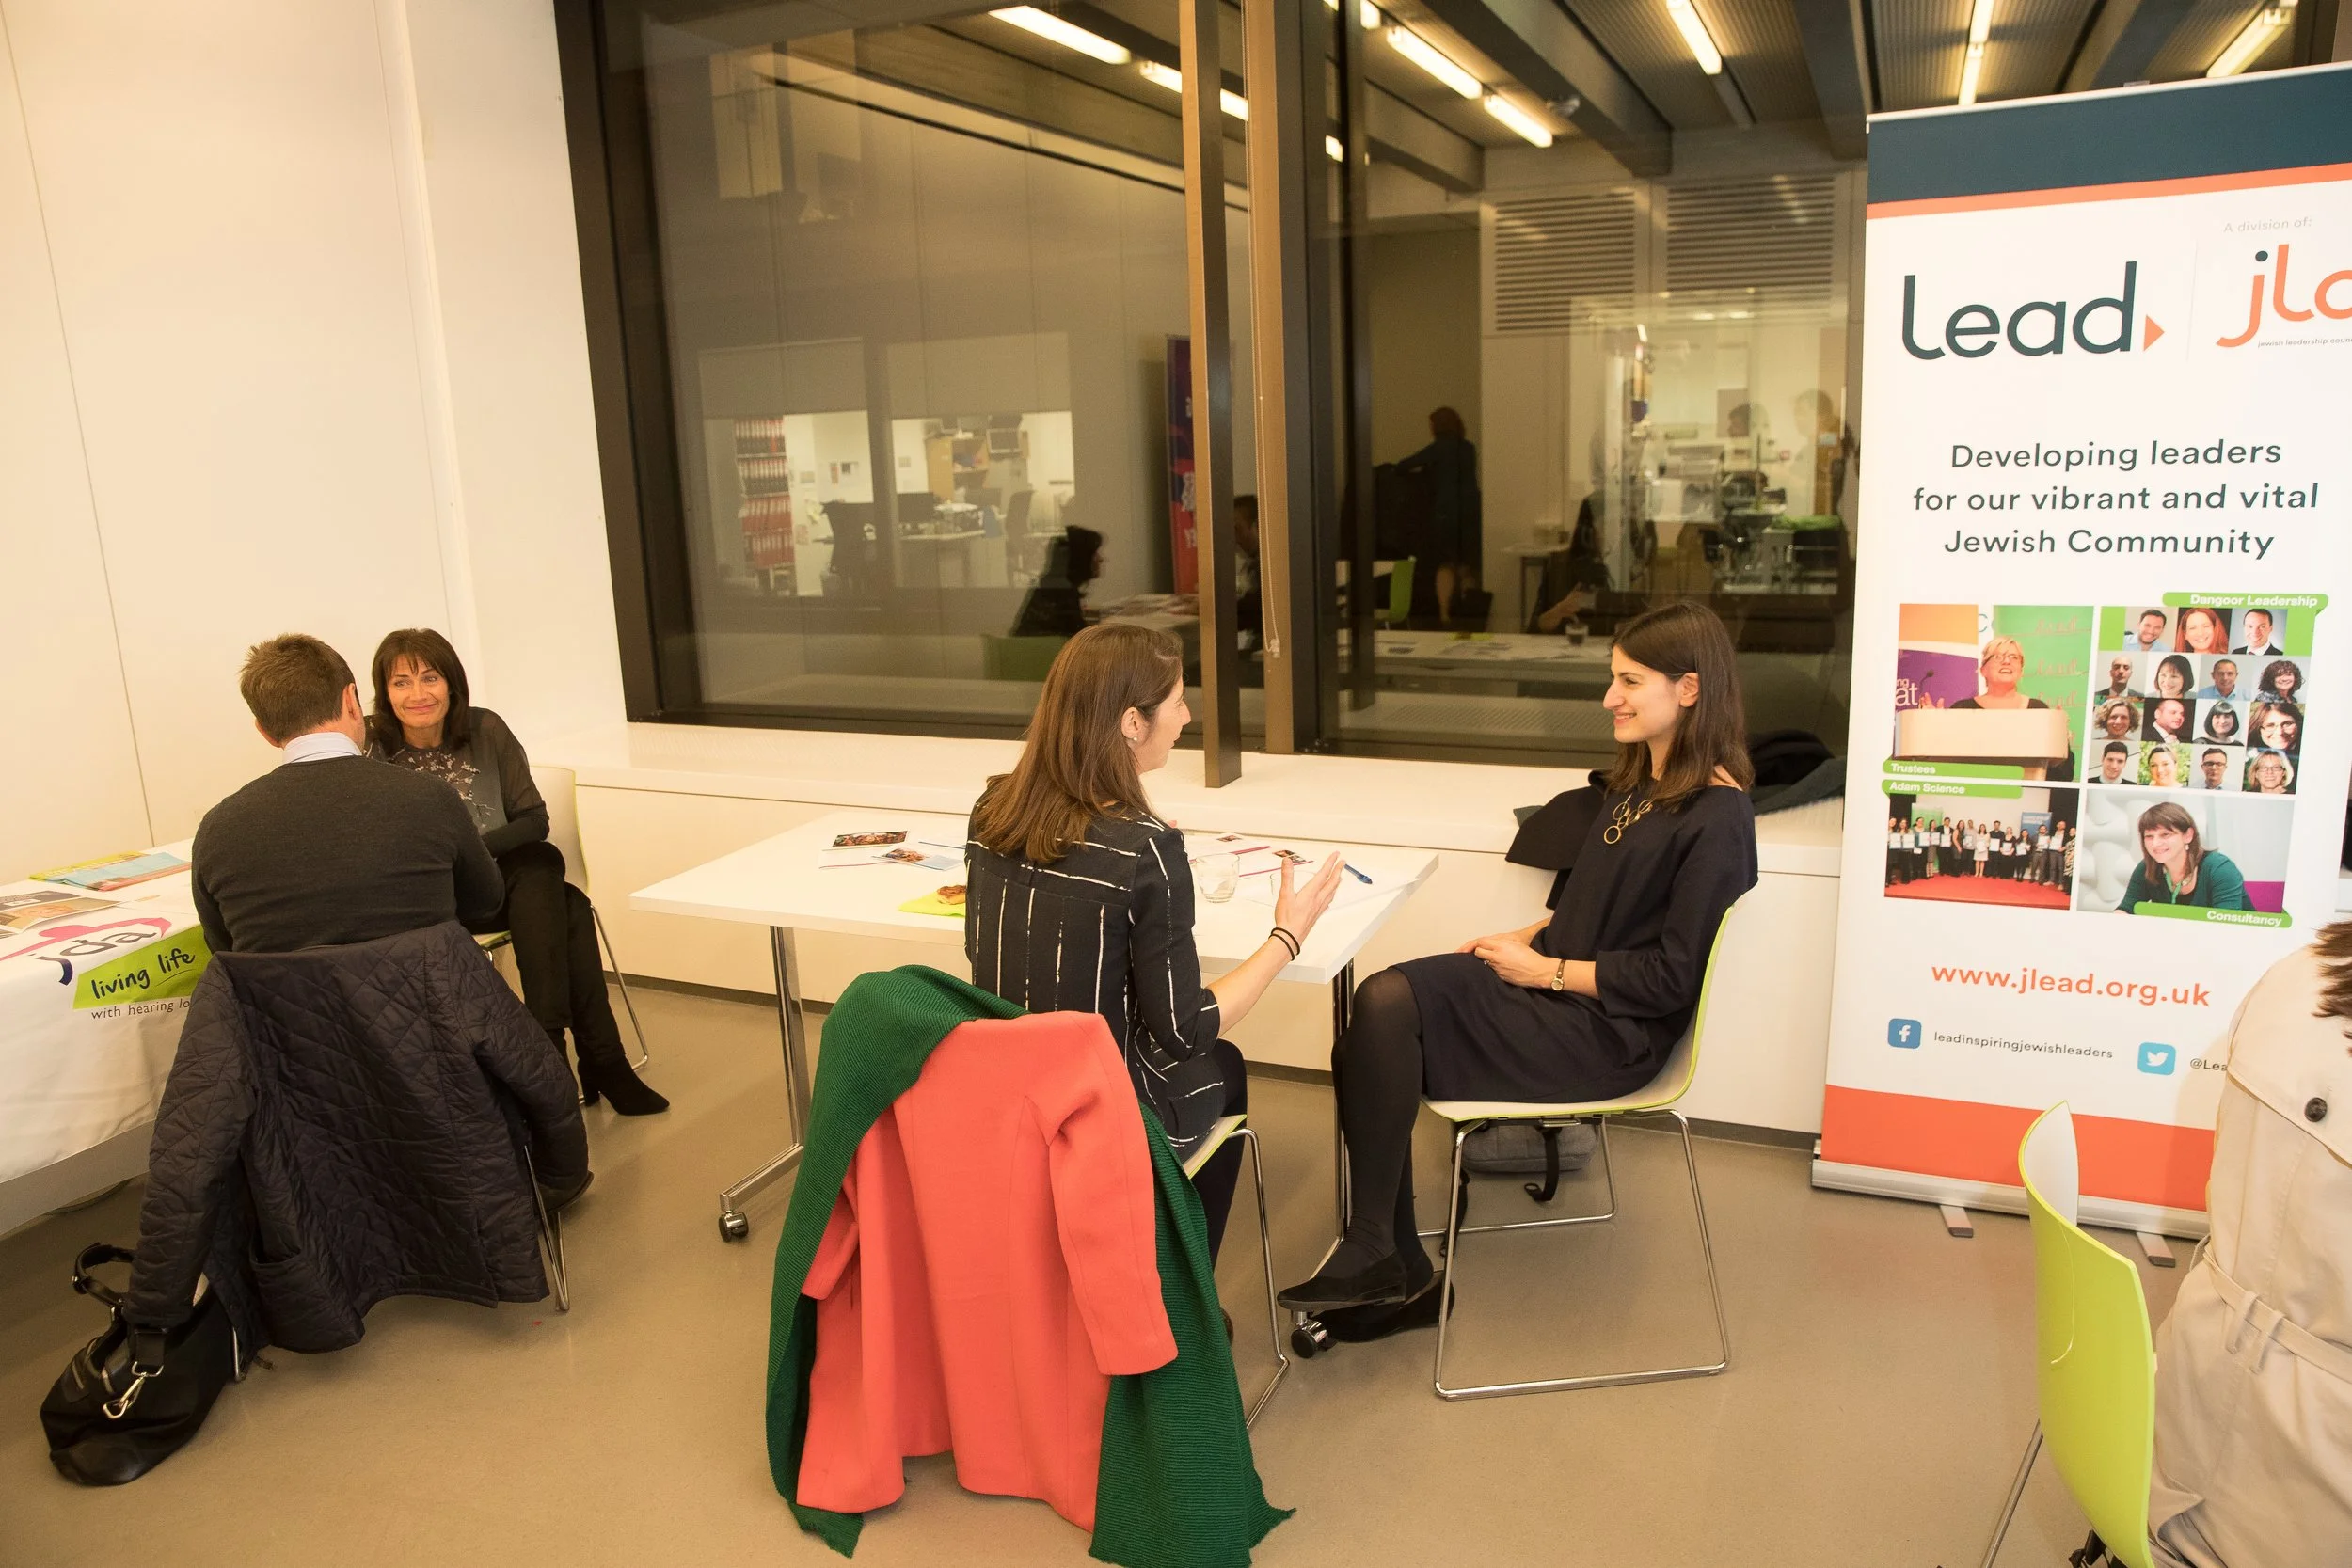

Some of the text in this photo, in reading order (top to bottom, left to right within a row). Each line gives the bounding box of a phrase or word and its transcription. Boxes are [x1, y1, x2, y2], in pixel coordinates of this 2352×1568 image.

[2223, 216, 2312, 233] A division of:
[2257, 339, 2284, 349] jewish
[2285, 337, 2328, 346] leadership
[1951, 438, 2281, 473] Developing leaders
[1913, 482, 2319, 511] for our vibrant and vital
[1944, 528, 2275, 561] Jewish Community
[2189, 594, 2318, 609] Dangoor Leadership
[1891, 763, 1936, 774] Trustees
[1889, 782, 1965, 794] Adam Science
[2206, 911, 2282, 927] Consultancy
[91, 947, 196, 999] living life
[1931, 966, 2211, 1006] www.jlead.org.uk
[91, 998, 191, 1020] with hearing lo
[1933, 1031, 2114, 1059] leadinspiringjewishleaders
[2189, 1057, 2229, 1072] @Lea
